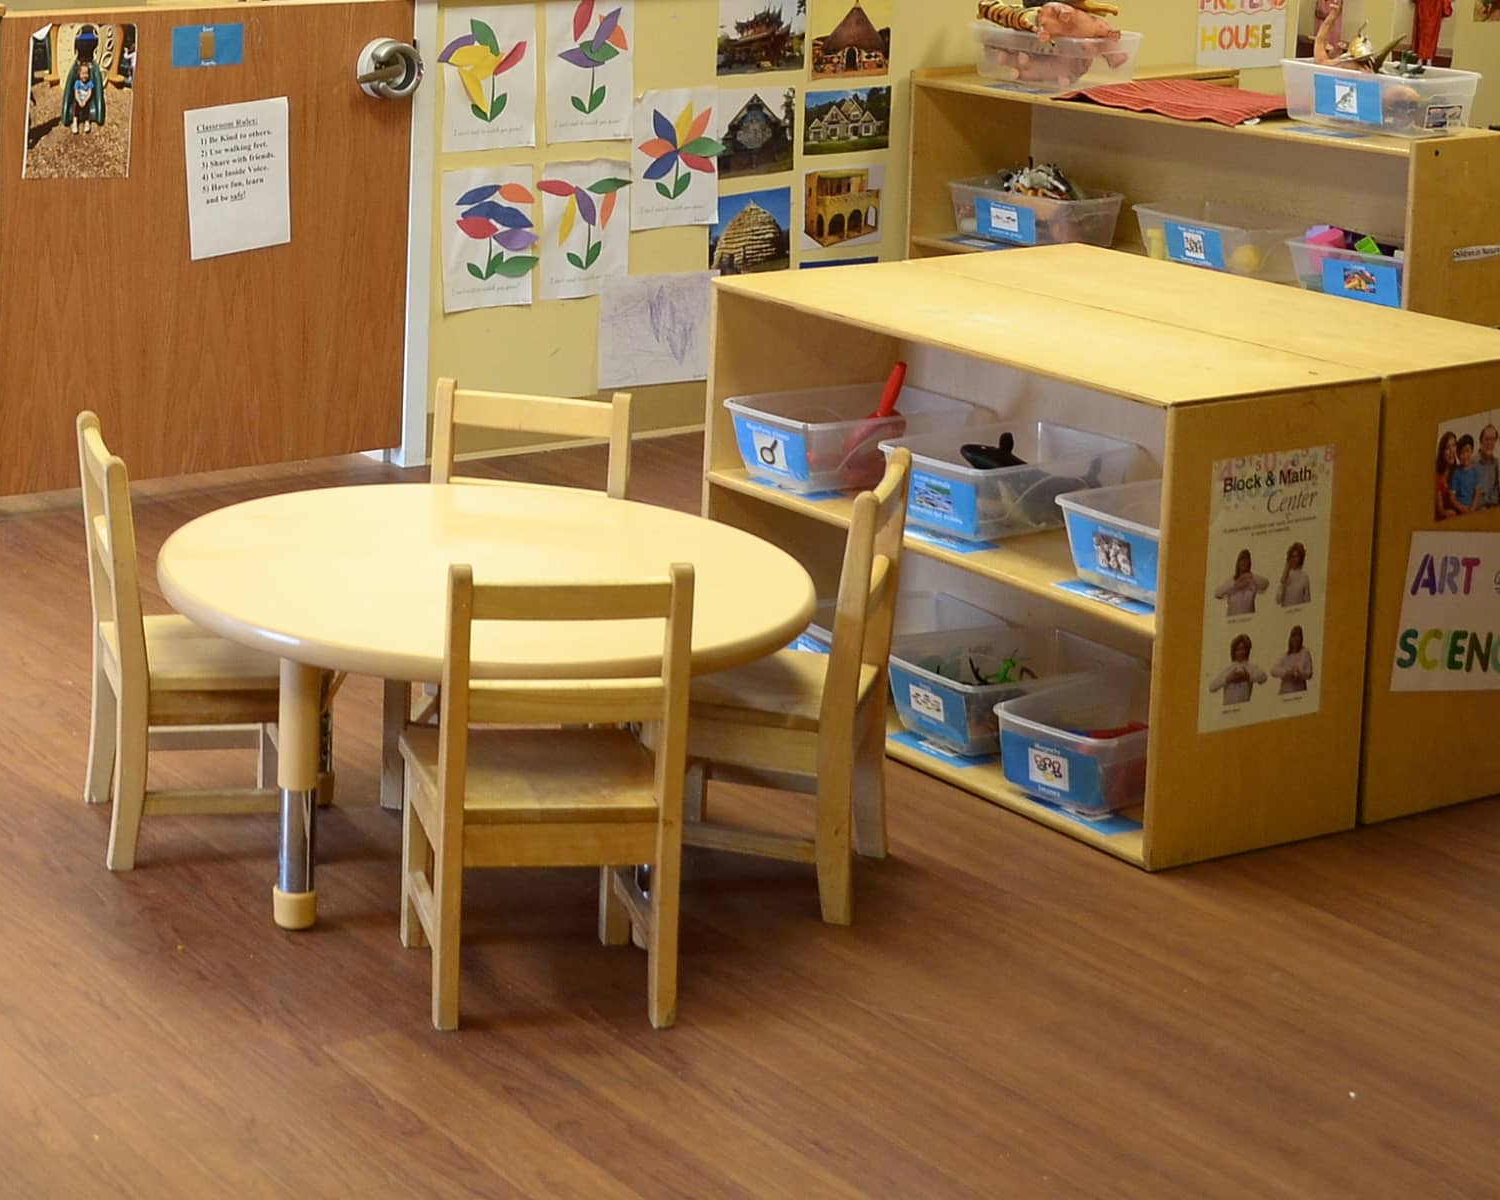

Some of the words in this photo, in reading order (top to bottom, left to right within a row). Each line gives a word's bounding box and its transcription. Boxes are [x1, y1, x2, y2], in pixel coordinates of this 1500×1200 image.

[1201, 23, 1273, 51] HOUSE
[220, 133, 238, 142] Kind
[206, 195, 219, 204] and
[220, 194, 228, 202] be
[211, 183, 228, 192] Have
[1223, 473, 1262, 494] Block
[1265, 469, 1275, 487] &
[1280, 465, 1312, 486] Math
[1266, 488, 1319, 514] Center
[1410, 553, 1481, 596] ART
